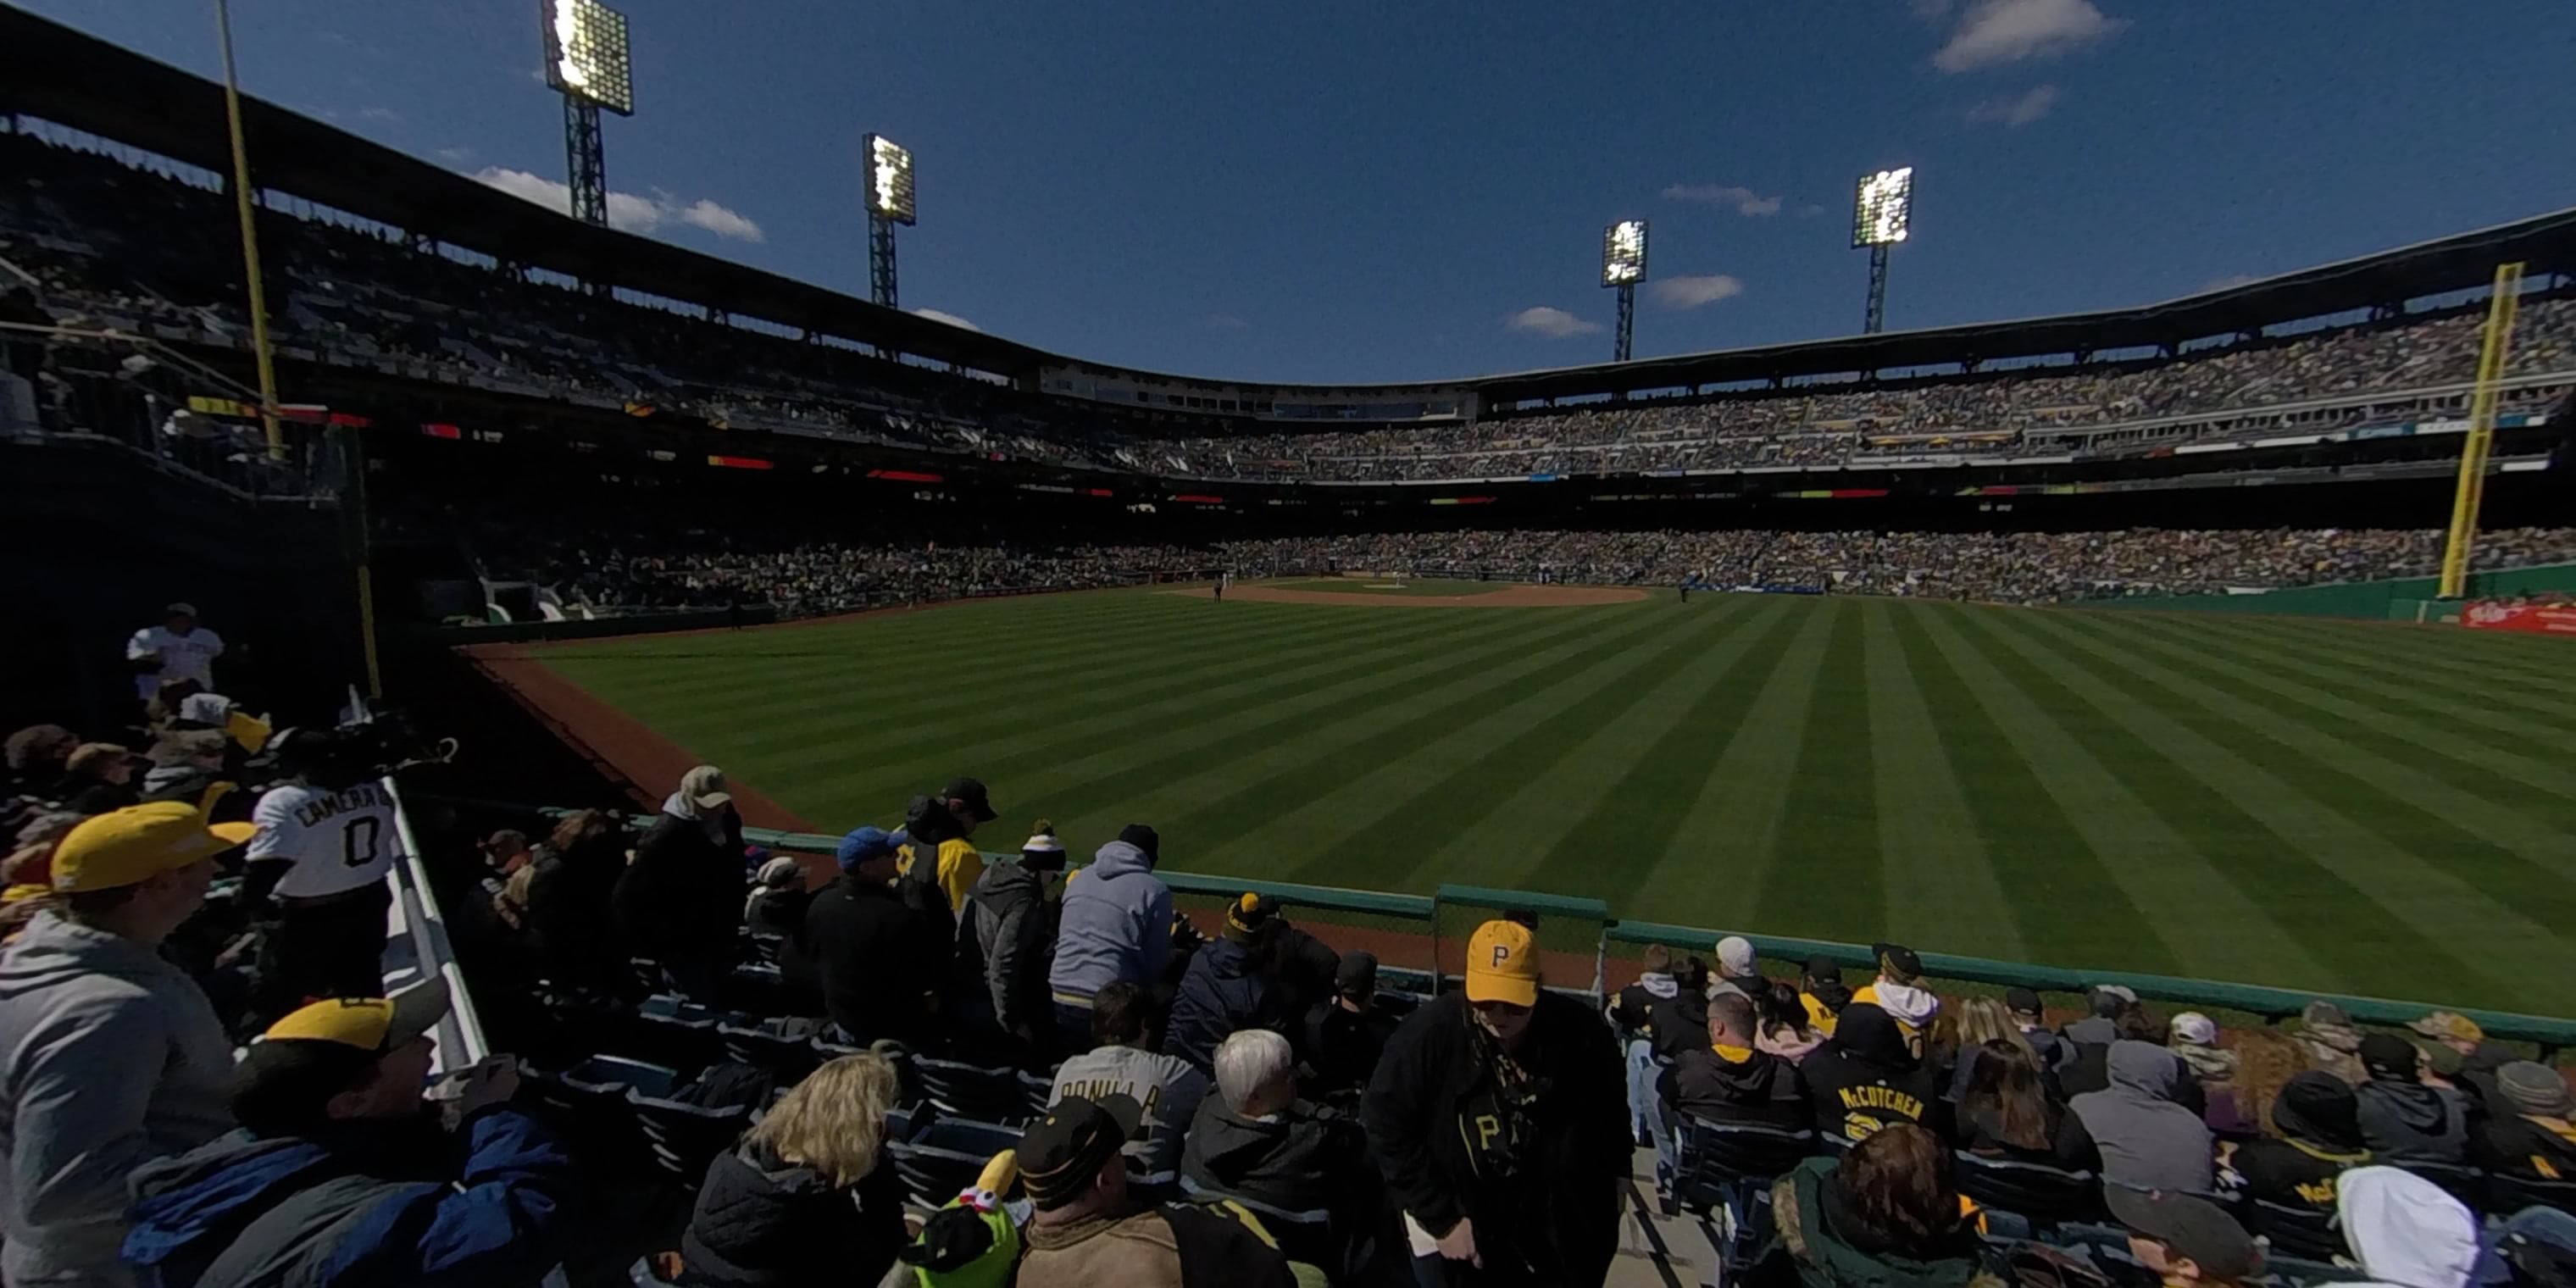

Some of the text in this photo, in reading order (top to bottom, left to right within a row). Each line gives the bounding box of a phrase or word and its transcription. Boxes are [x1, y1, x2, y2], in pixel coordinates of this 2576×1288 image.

[345, 816, 380, 868] 0
[1491, 944, 1510, 970] P
[1474, 1113, 1502, 1152] P
